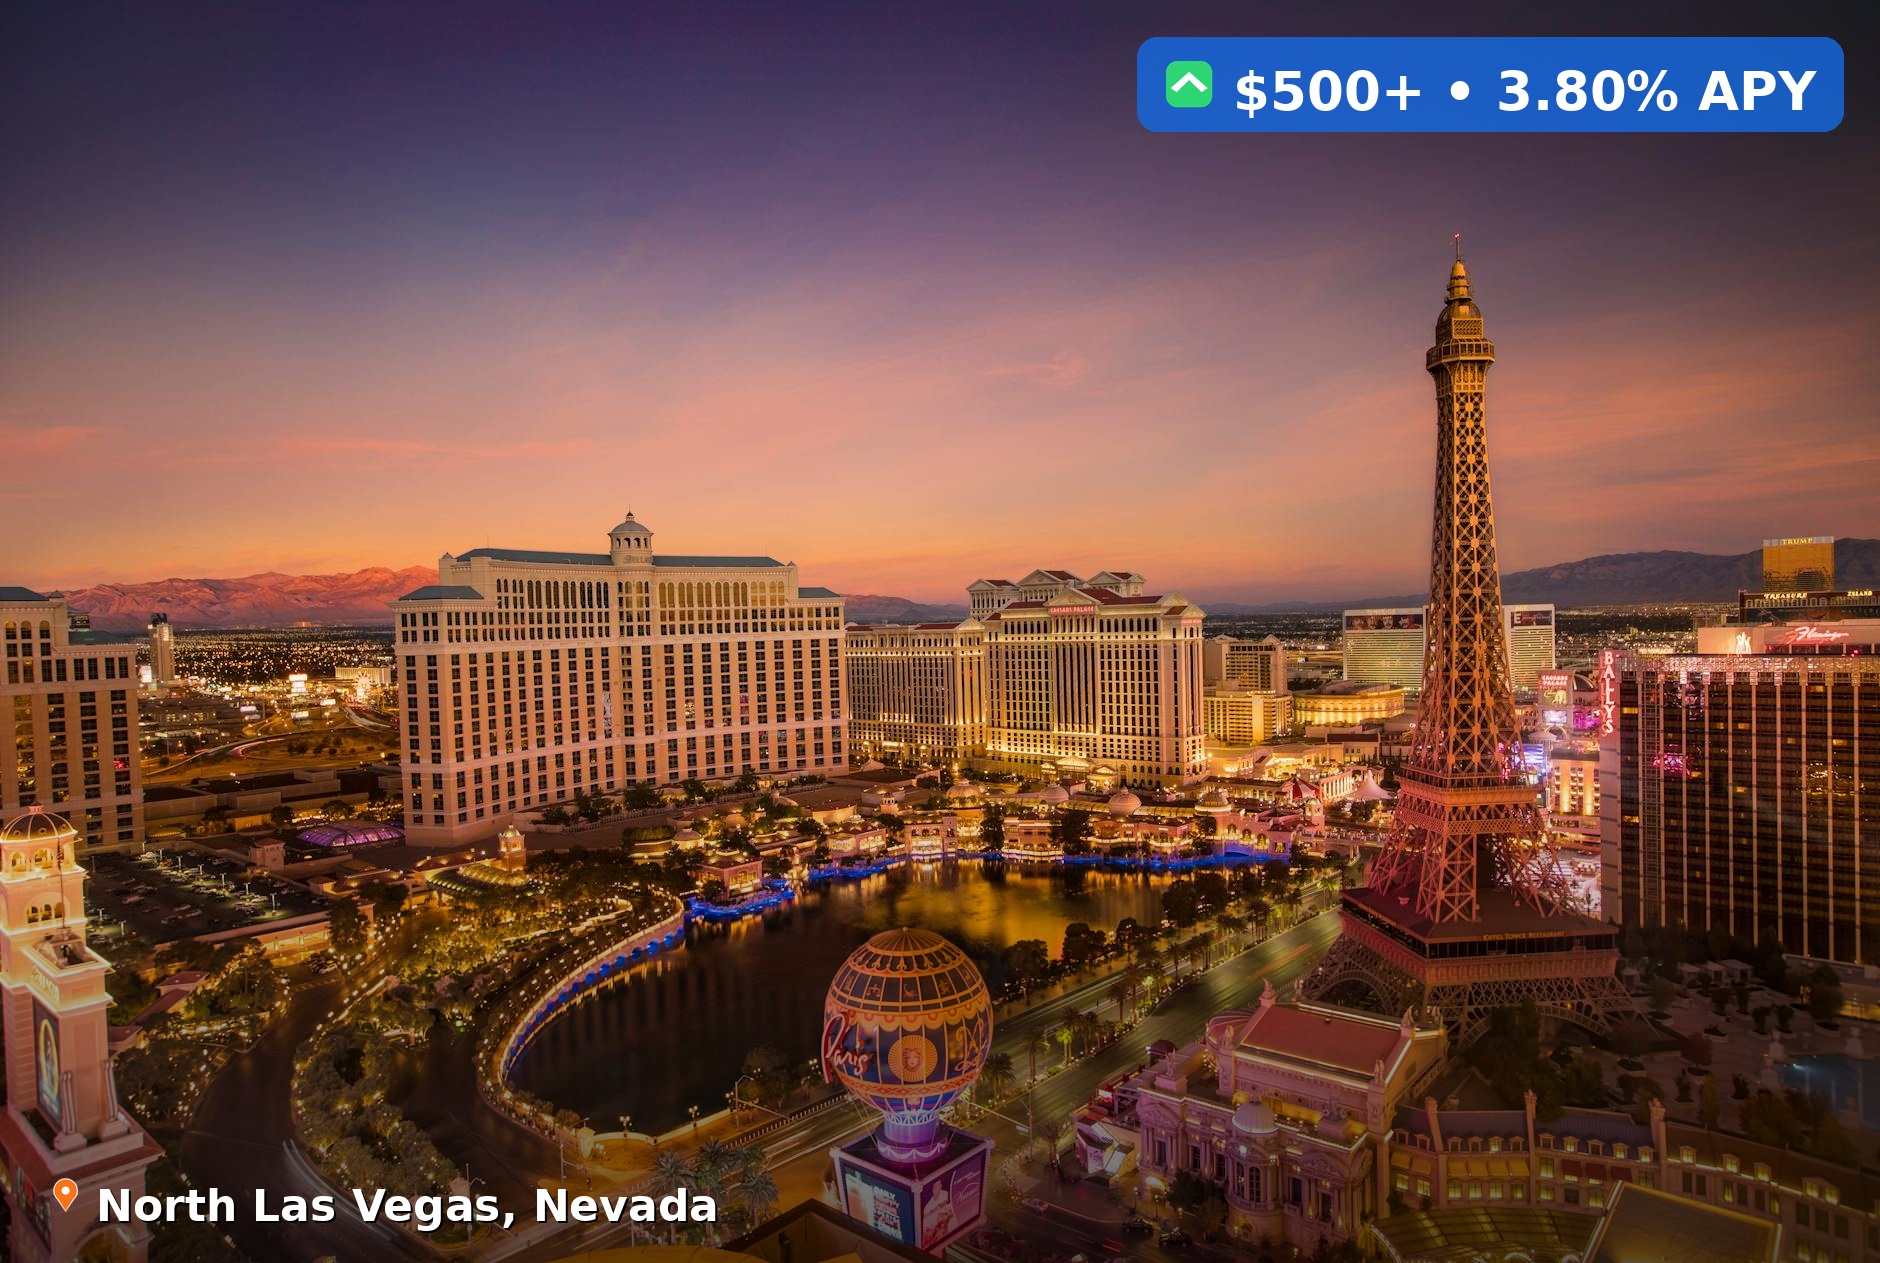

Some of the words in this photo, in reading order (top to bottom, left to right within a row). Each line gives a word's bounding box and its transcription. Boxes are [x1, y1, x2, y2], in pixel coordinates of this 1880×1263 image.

[1782, 536, 1813, 545] TRUMP
[1763, 592, 1808, 600] TREASURE
[1073, 605, 1094, 613] PALACE
[1795, 626, 1849, 641] Flamingo
[1504, 932, 1526, 940] TOWER
[821, 1013, 870, 1085] Paris
